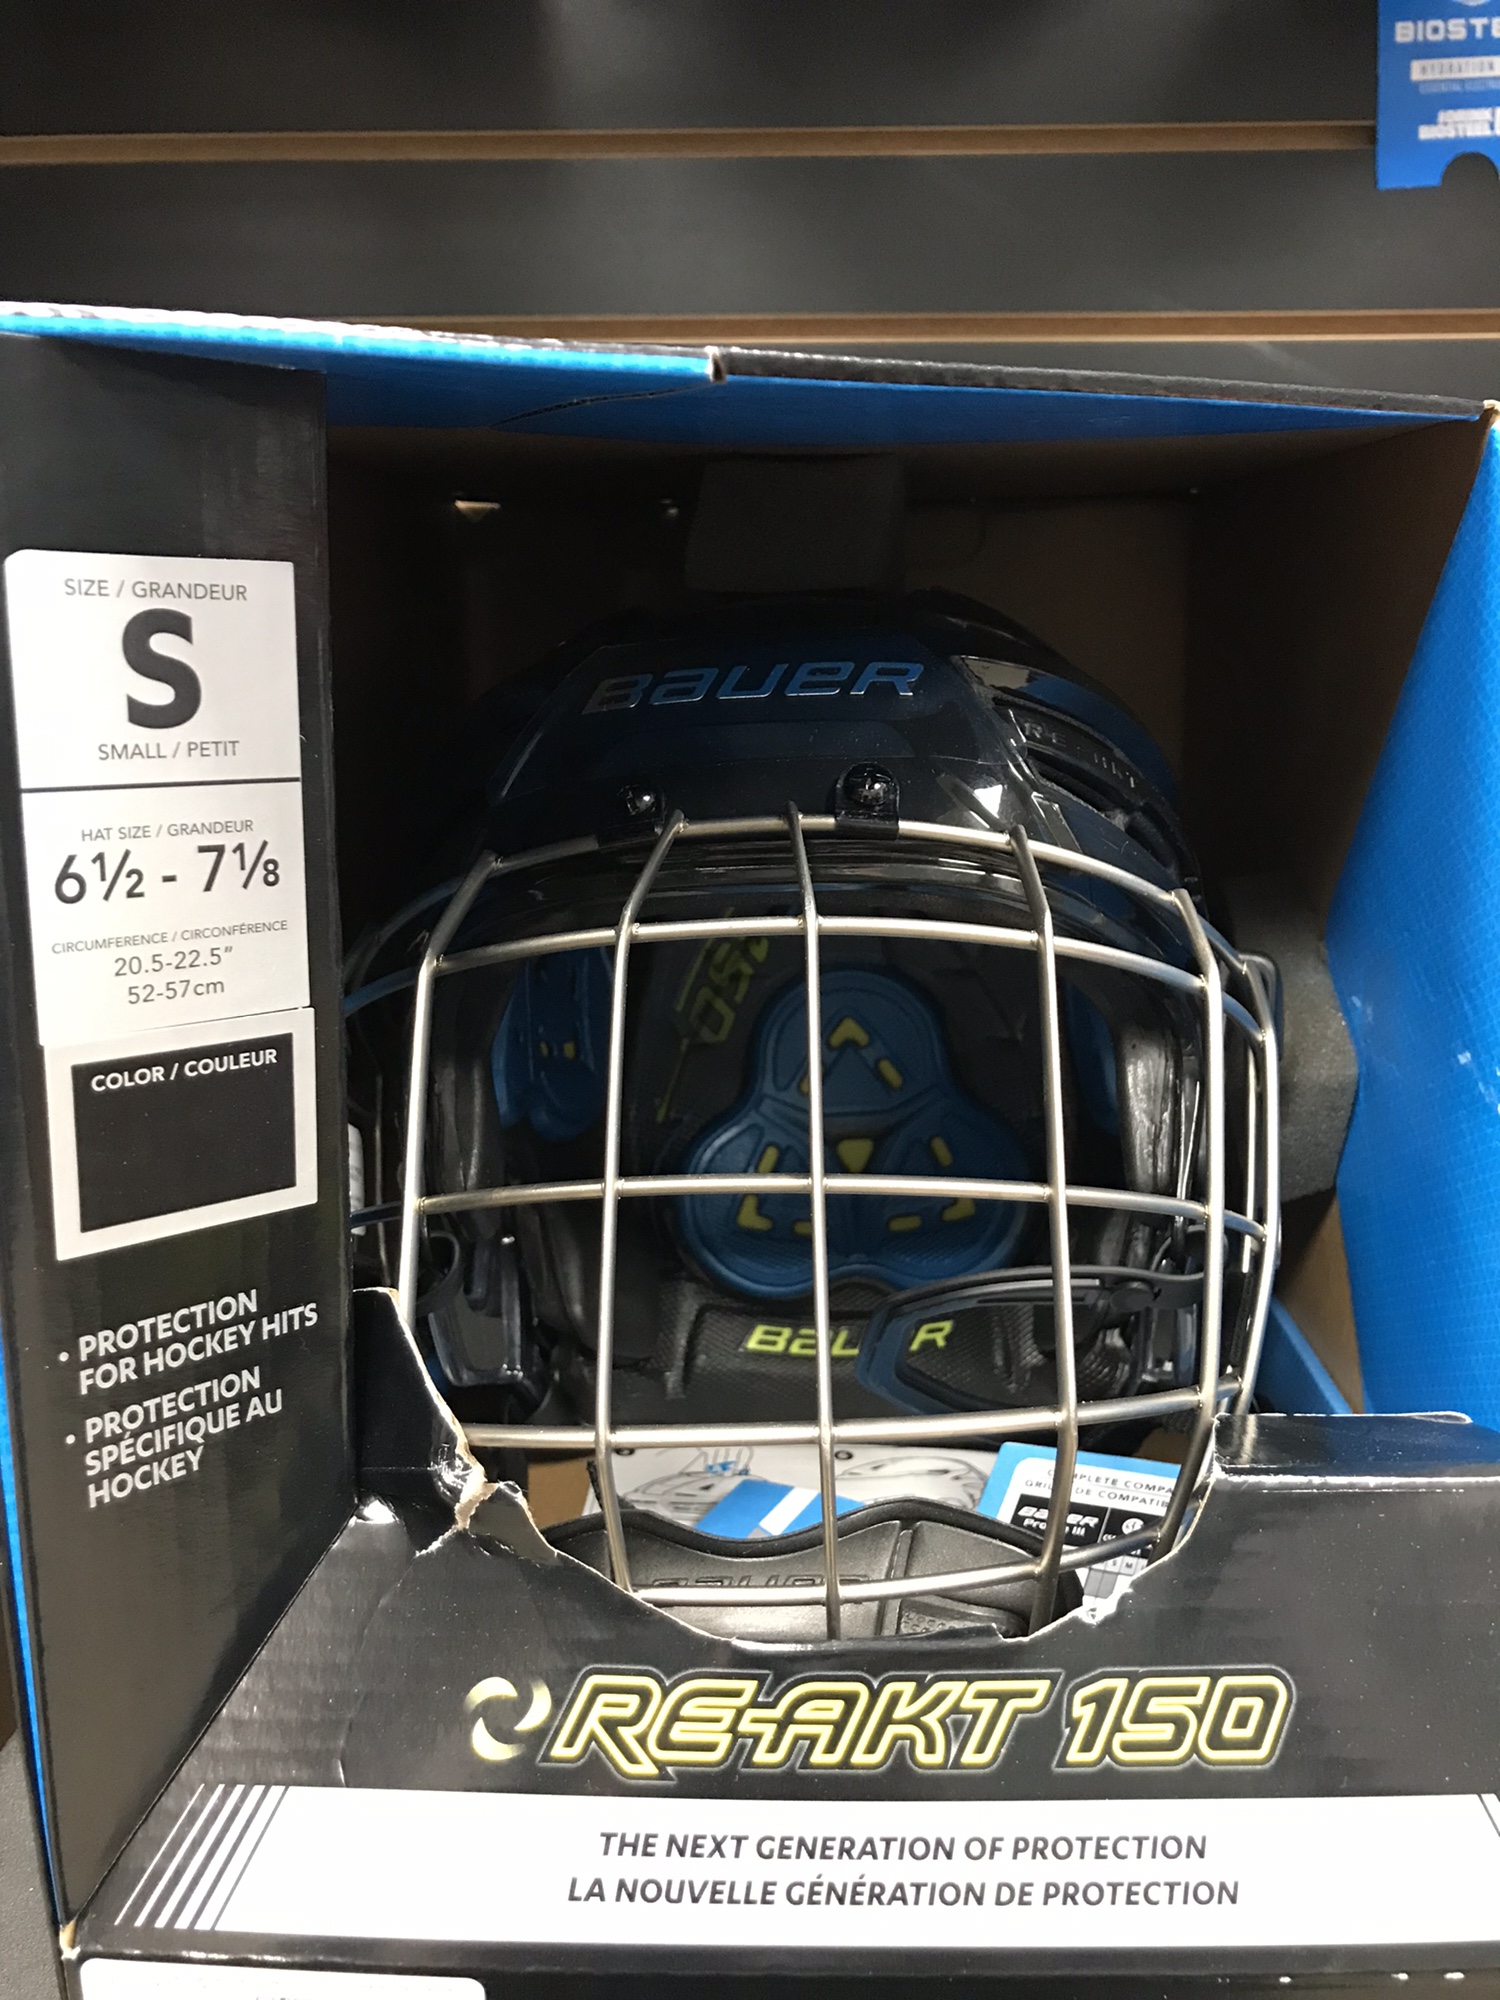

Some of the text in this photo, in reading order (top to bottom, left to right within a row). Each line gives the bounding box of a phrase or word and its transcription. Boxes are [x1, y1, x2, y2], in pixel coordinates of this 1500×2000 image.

[64, 578, 110, 598] SIZE
[132, 581, 248, 601] GRANDEUR
[122, 608, 202, 729] S
[98, 743, 167, 761] SMALL
[187, 740, 240, 758] PETIT
[81, 827, 113, 842] HAT
[118, 825, 151, 840] SIZE
[167, 819, 254, 838] GRANDEUR
[51, 931, 168, 955] CIRCUMFERENCE
[180, 920, 288, 942] CIRCONFÉRENCE
[91, 1065, 165, 1092] COLOR
[184, 1048, 278, 1078] COULEUR
[78, 1288, 258, 1362] PROTECTION
[79, 1302, 319, 1395] FOR HOCKEY HITS
[85, 1365, 261, 1444] PROTECTION
[85, 1388, 283, 1477] SPÉCIFIQUE AU
[88, 1445, 204, 1508] HOCKEY
[1047, 1469, 1174, 1494] CPLETE COMPA
[1075, 1486, 1092, 1497] DE
[1098, 1490, 1169, 1508] COMPATIB
[1017, 1505, 1099, 1528] BAER
[545, 1669, 1292, 1780] RE-AKT 150
[600, 1832, 1207, 1861] THE NEXT GENERATION OF PROTECTION
[568, 1873, 1239, 1906] LA NOUVELLE GÉNÉRATION DE PROTECTION
